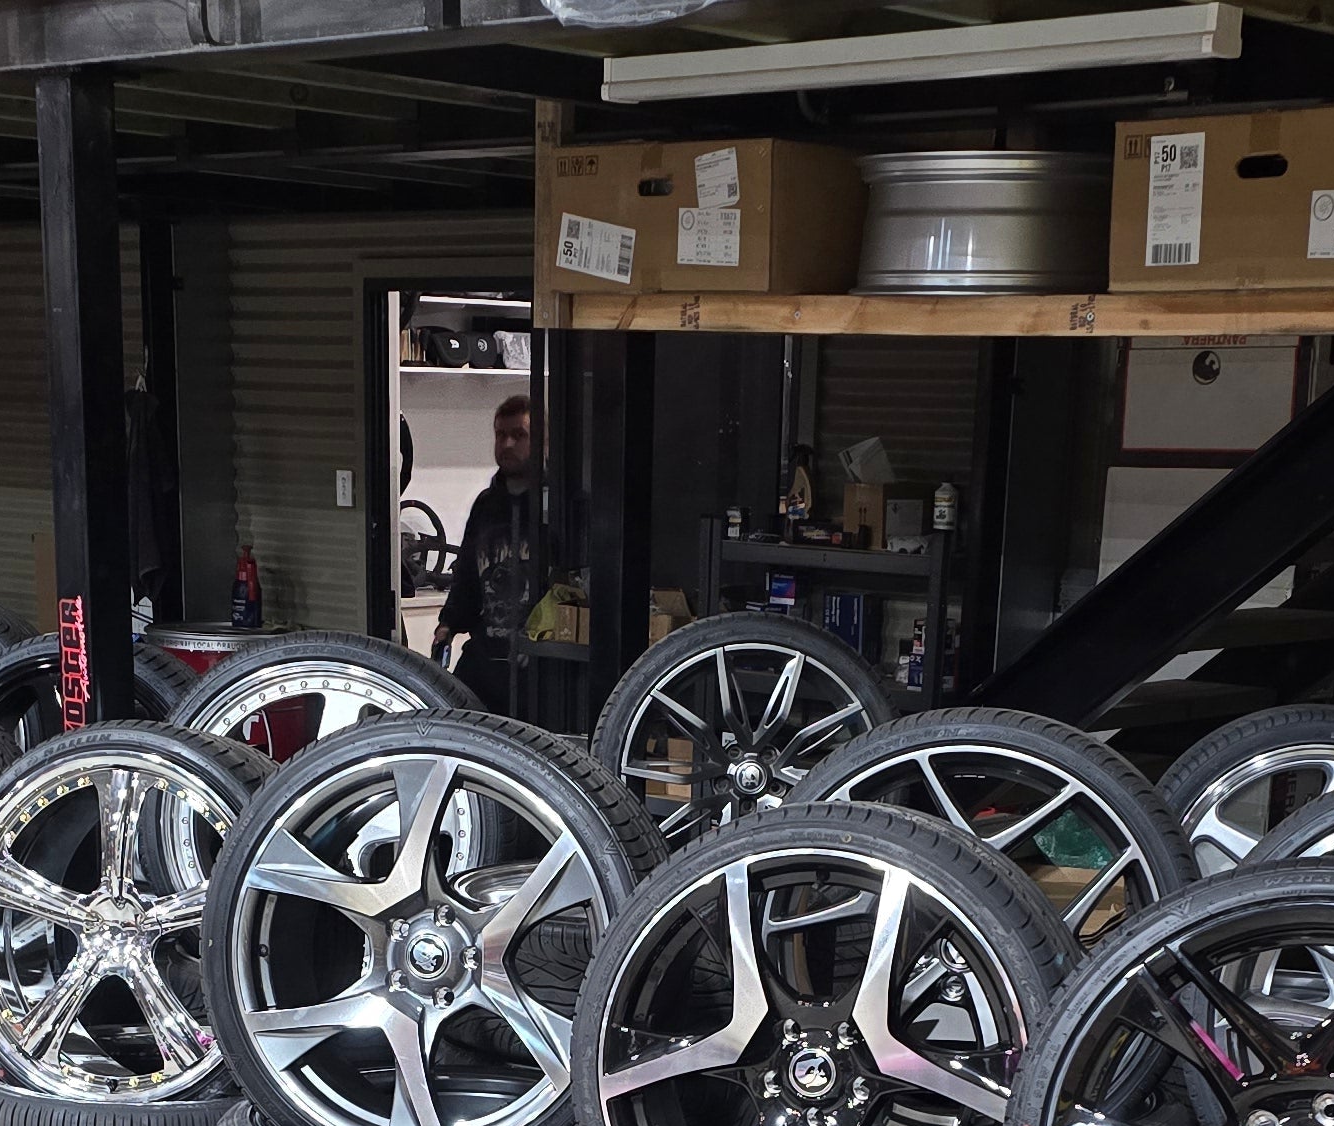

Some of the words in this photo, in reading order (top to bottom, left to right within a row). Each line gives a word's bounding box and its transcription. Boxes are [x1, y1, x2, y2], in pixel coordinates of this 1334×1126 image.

[1161, 144, 1177, 162] 50
[563, 241, 574, 257] 50
[1183, 335, 1247, 346] PANTHERA
[193, 642, 215, 650] LOCAL
